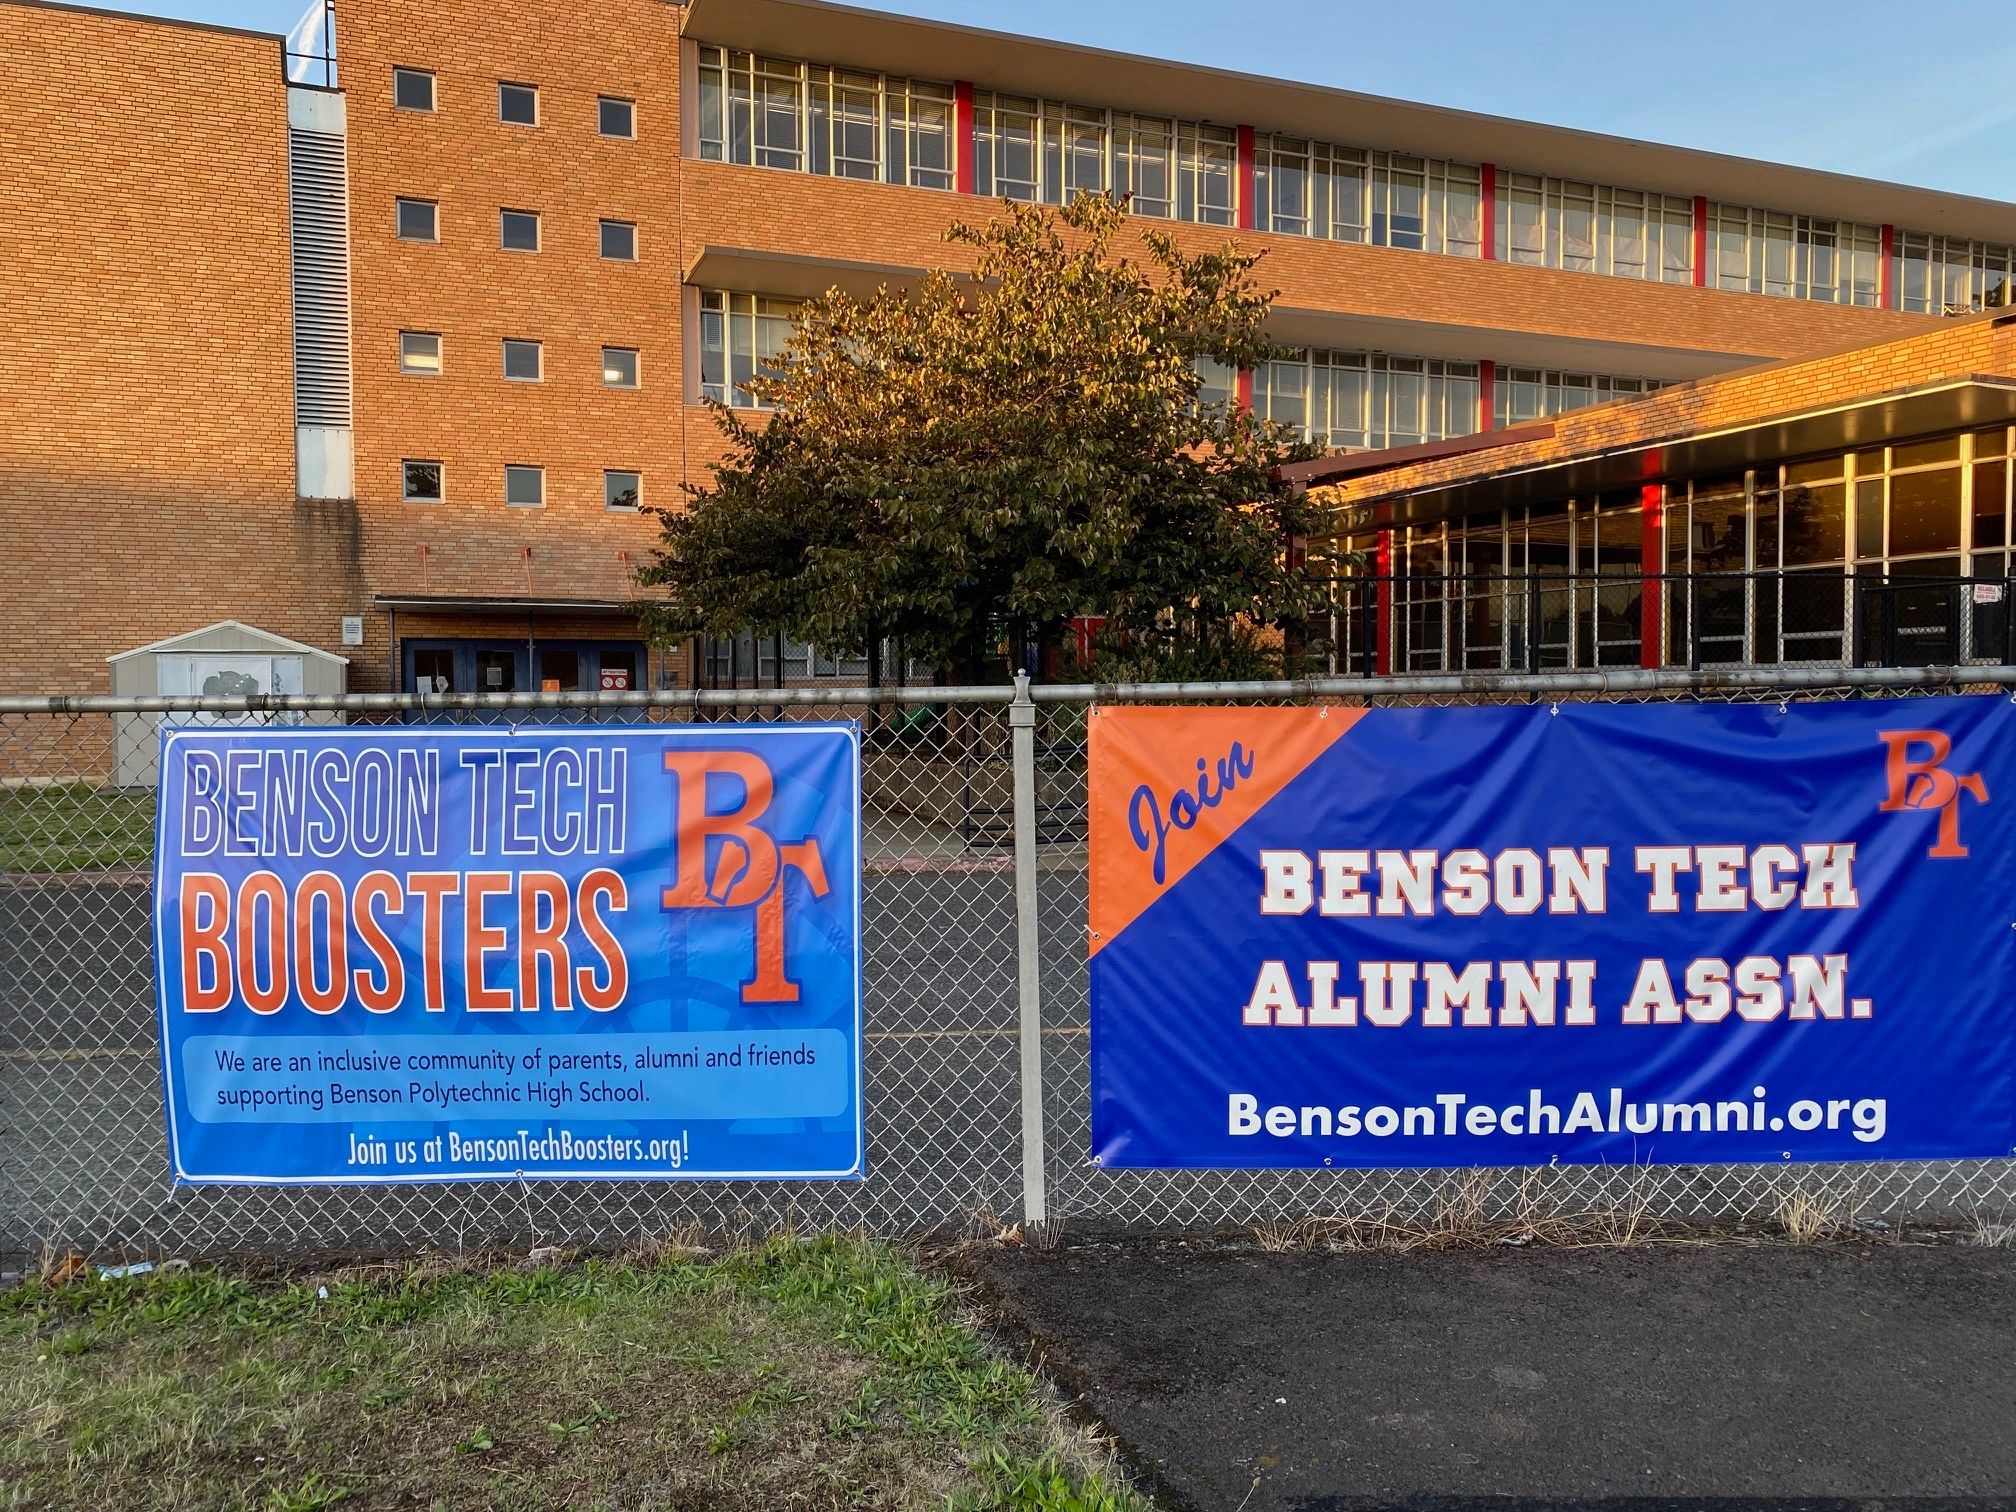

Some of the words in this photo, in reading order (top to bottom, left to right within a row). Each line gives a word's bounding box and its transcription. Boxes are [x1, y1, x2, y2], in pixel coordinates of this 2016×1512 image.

[180, 747, 440, 859] BENSON
[459, 746, 628, 856] TECH
[1127, 738, 1255, 886] Join
[1259, 846, 1610, 917] BENSON
[1635, 842, 1861, 912] TECH
[179, 866, 630, 1016] BOOSTERS
[1242, 959, 1597, 1028] ALUMNI
[1622, 953, 1873, 1026] ASSN.
[214, 1050, 246, 1072] We
[252, 1054, 282, 1072] are
[288, 1053, 312, 1072] an
[317, 1049, 402, 1071] inclusive
[407, 1049, 516, 1076] community
[522, 1047, 543, 1070] of
[549, 1050, 628, 1077] parents,
[634, 1045, 700, 1069] alumni
[705, 1043, 742, 1067] and
[748, 1042, 816, 1066] friends
[216, 1084, 324, 1112] supporting
[330, 1083, 402, 1104] Benson
[408, 1080, 521, 1108] Polytechnic
[527, 1081, 573, 1108] High
[579, 1079, 650, 1103] School.
[347, 1132, 388, 1165] Join
[394, 1140, 417, 1164] us
[423, 1135, 443, 1163] at
[449, 1127, 689, 1168] BensonTechBoosters.org!
[1228, 1086, 1887, 1143] BensonTechAlumni.org
